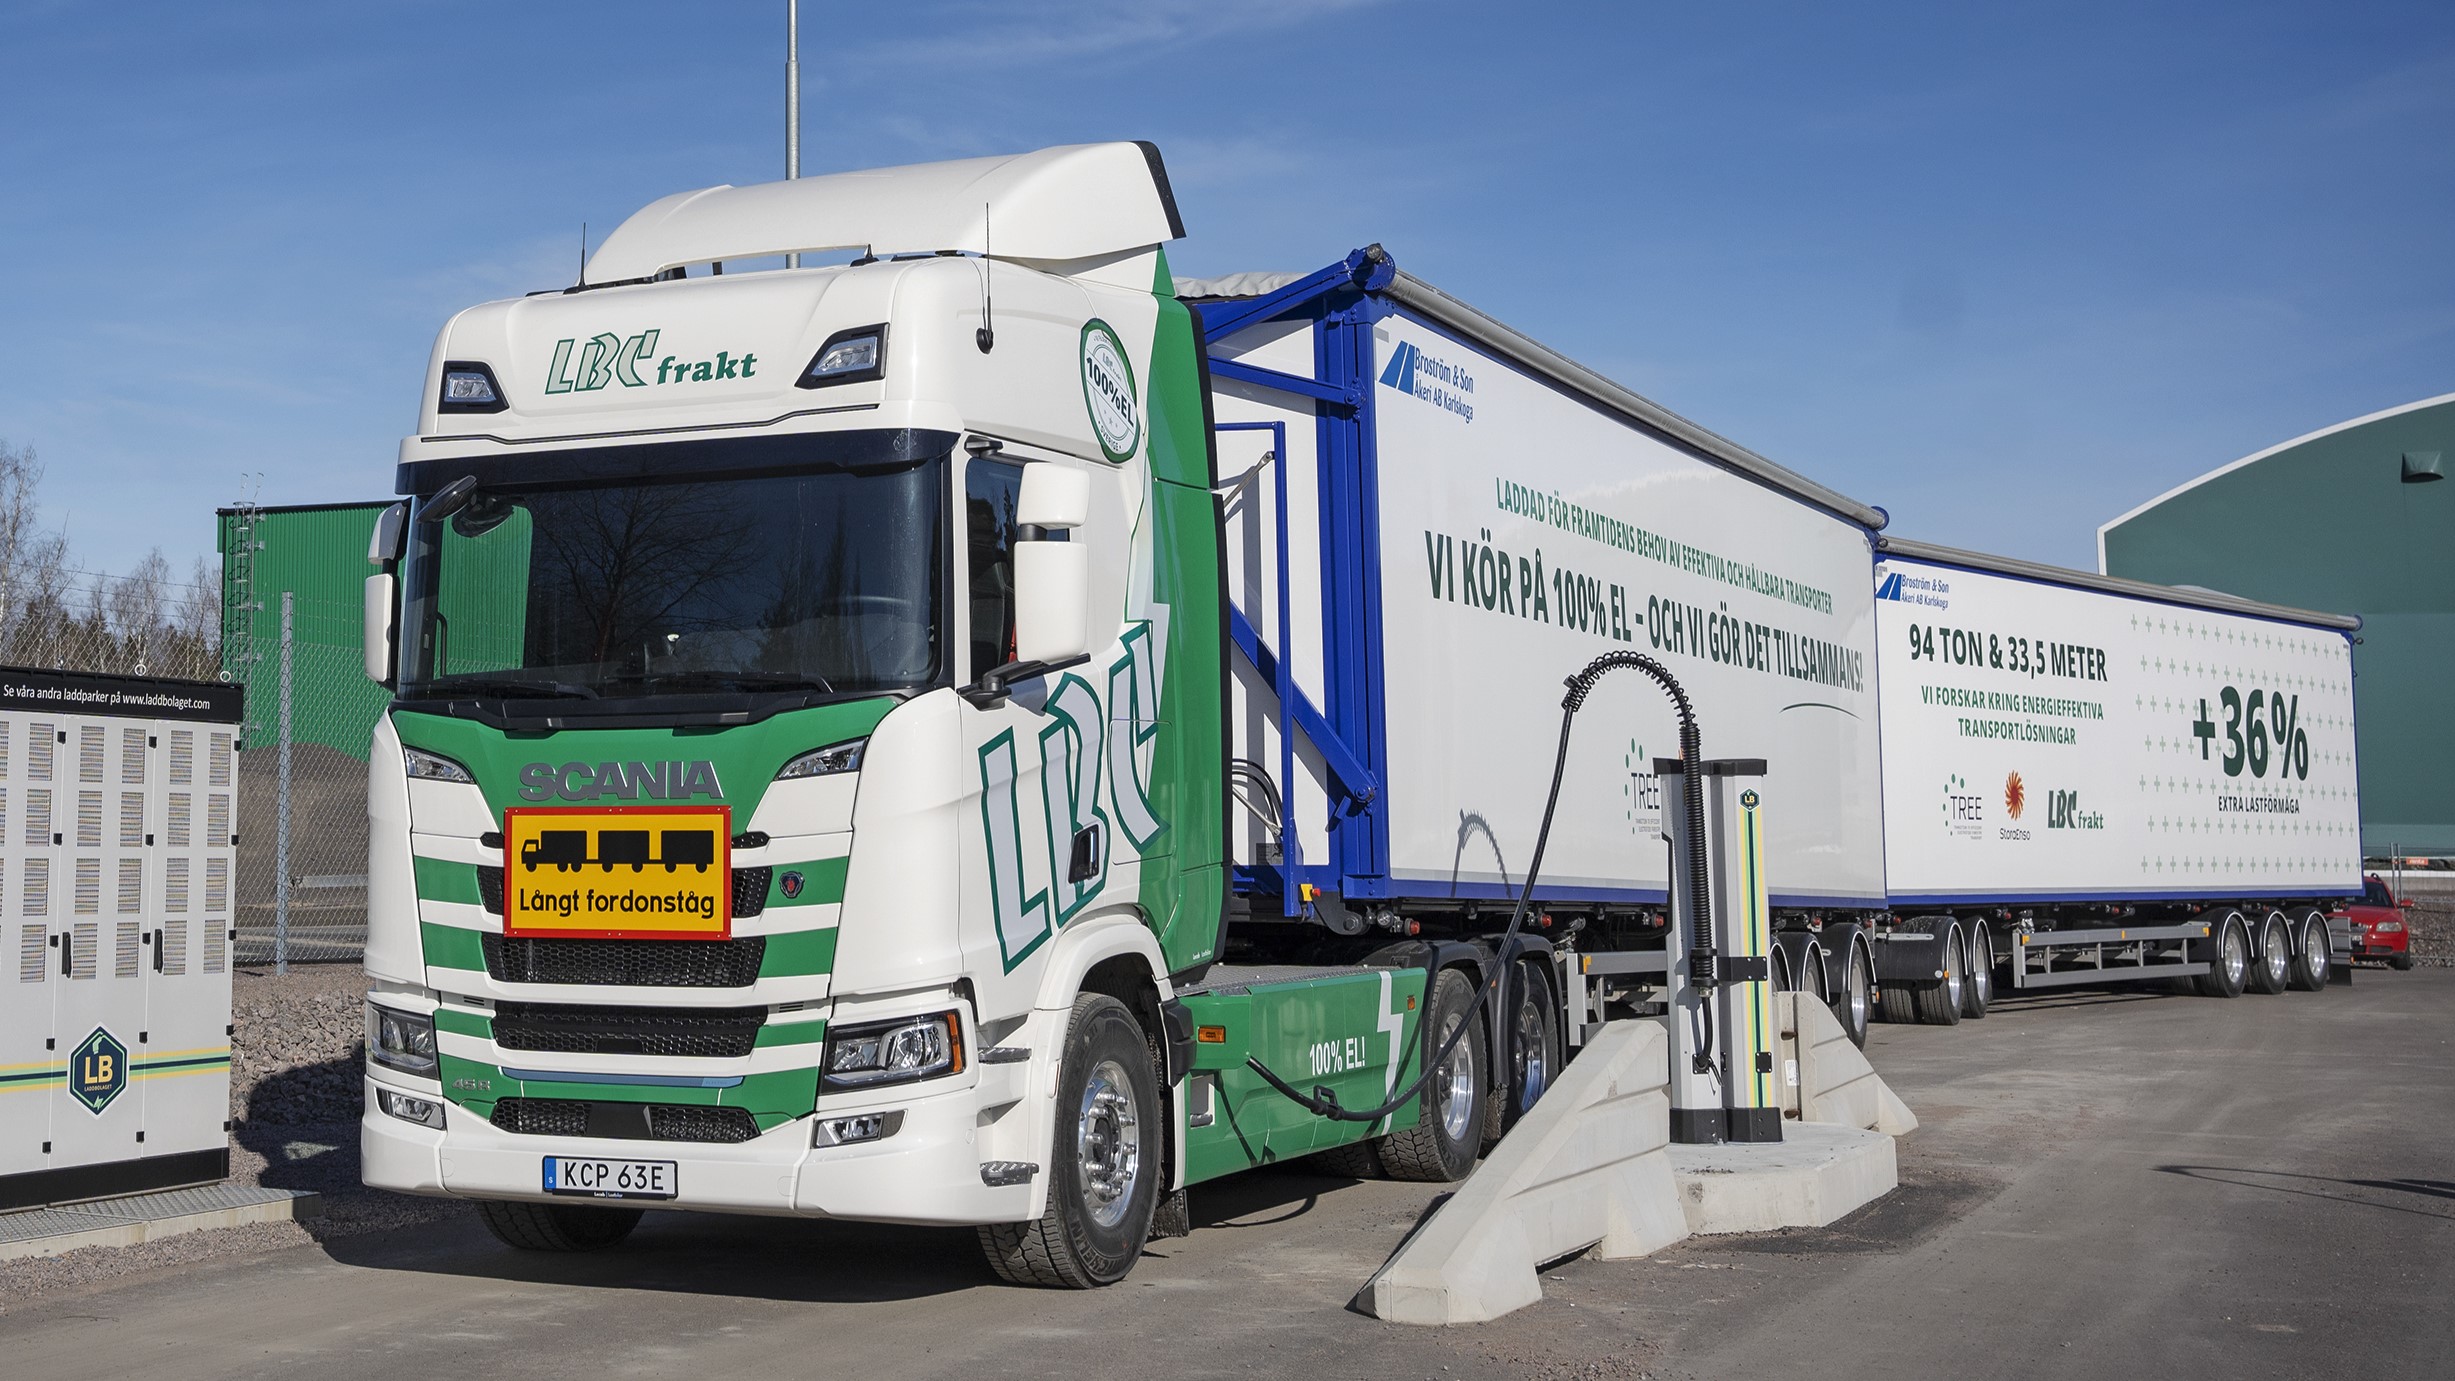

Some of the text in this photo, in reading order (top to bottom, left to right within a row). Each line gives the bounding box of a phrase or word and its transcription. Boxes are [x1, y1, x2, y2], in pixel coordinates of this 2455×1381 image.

[545, 329, 757, 394] LBC frakt
[1415, 347, 1473, 394] Broström & Son
[1414, 374, 1473, 424] Åkeri AB Karlskoga
[1496, 477, 1833, 615] LADDAD FÖR FRAMTIDENS BEHOV AV EFFEKTIVA OCH HÅLLBARA TRANSPORTER
[1901, 575, 1949, 593] Broström & Son
[1901, 589, 1948, 611] Åkeri AB Karlskoga
[1424, 530, 1454, 602] VI
[1461, 527, 1515, 616] KÖR
[1519, 548, 1549, 624] PÅ
[1553, 568, 1607, 637] 100%
[1610, 583, 1632, 642] EL
[1648, 594, 1684, 654] OCH
[1687, 605, 1705, 659] VI
[1708, 600, 1742, 668] GÖR
[1744, 621, 1770, 673] DET
[1773, 628, 1864, 693] TILLSAMMANS!
[1909, 623, 2108, 682] 94 TON & 33,5 METER
[3, 684, 210, 710] Se våra andra laddparker på www.laddbolaget.com
[1921, 685, 2104, 720] VI FORSKAR KRING ENERGIEFFEKTIVA
[1958, 718, 2076, 745] TRANSPORTLÖSNINGAR
[2193, 686, 2309, 781] +36%
[518, 761, 724, 801] SCANIA
[978, 620, 1171, 976] LBC
[1631, 772, 1660, 809] TREE
[1744, 795, 1755, 804] LB
[1950, 796, 1982, 820] TREE
[2048, 789, 2104, 830] LBC frakt
[2218, 794, 2300, 814] EXTRA LASTFÖRMÅGA
[520, 888, 714, 919] Långt fordonståg
[84, 1055, 113, 1084] LB
[1309, 1036, 1365, 1076] 100% EL!
[564, 1162, 664, 1191] KCP 63E
